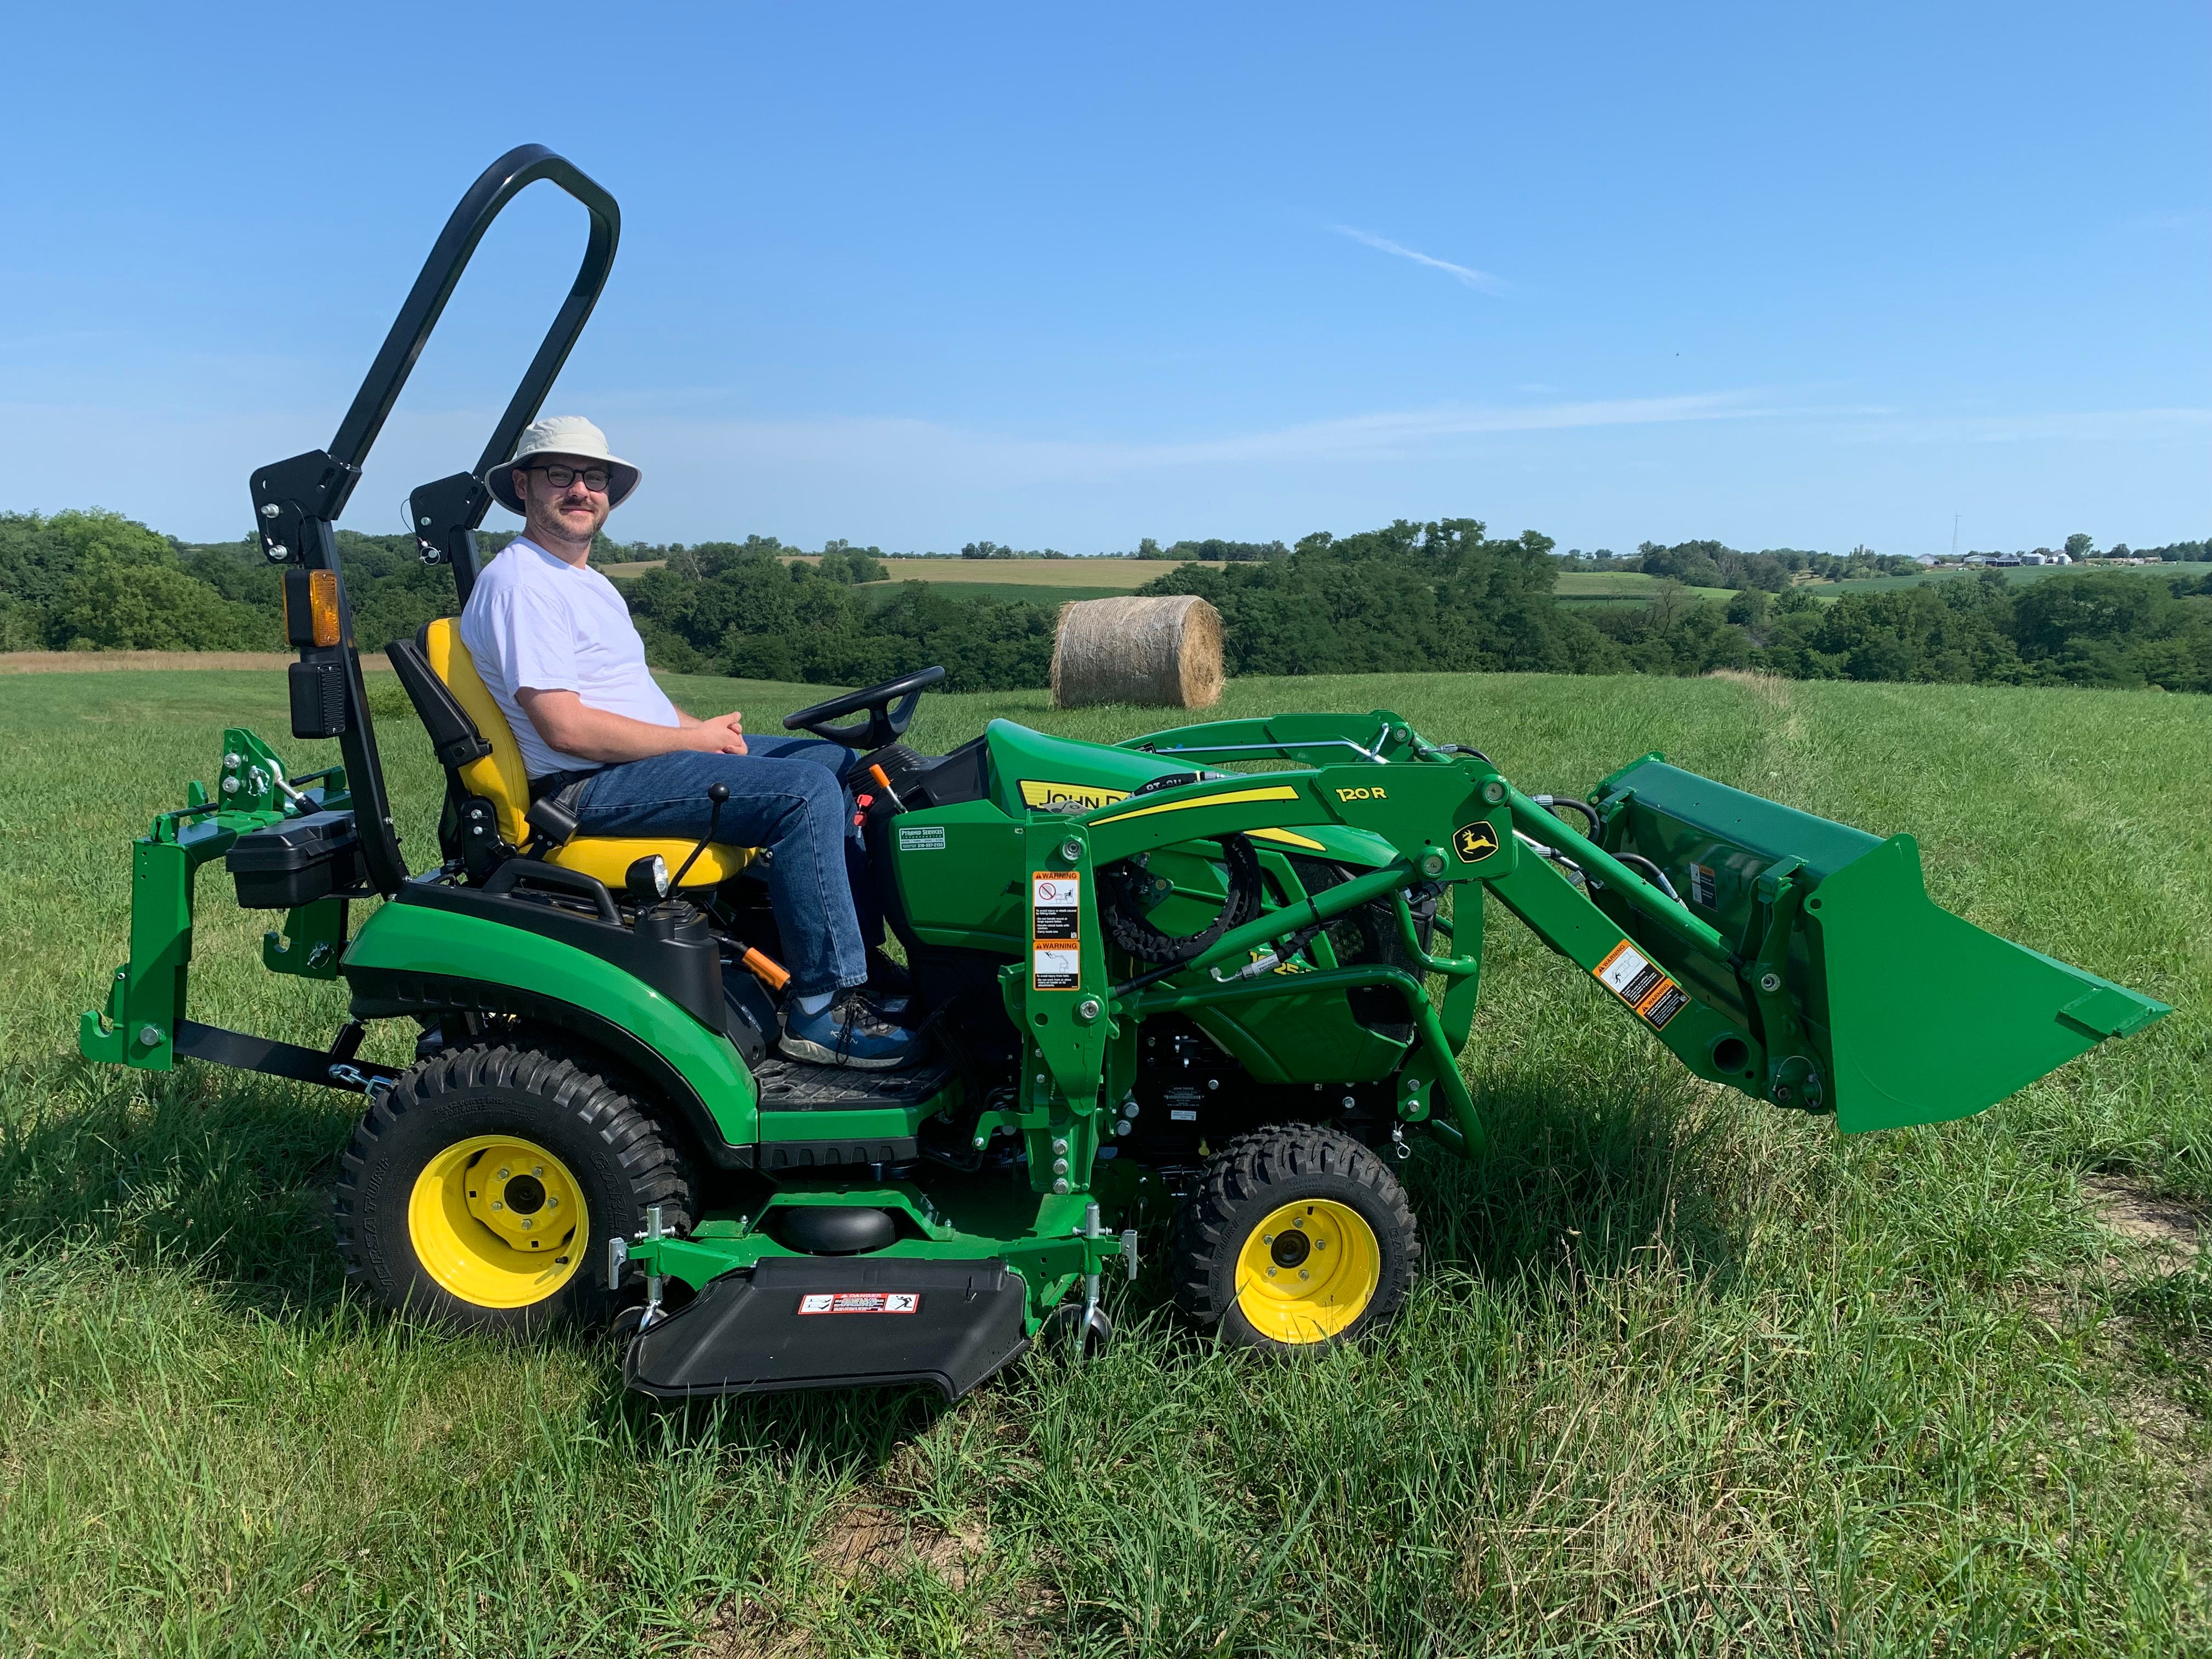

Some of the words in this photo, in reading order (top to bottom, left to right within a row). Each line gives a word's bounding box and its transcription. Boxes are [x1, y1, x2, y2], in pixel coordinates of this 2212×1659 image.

[1039, 789, 1099, 809] JOHN
[1602, 944, 1625, 967] WARNING
[1647, 983, 1669, 1005] WARNING
[364, 1152, 390, 1214] TURF
